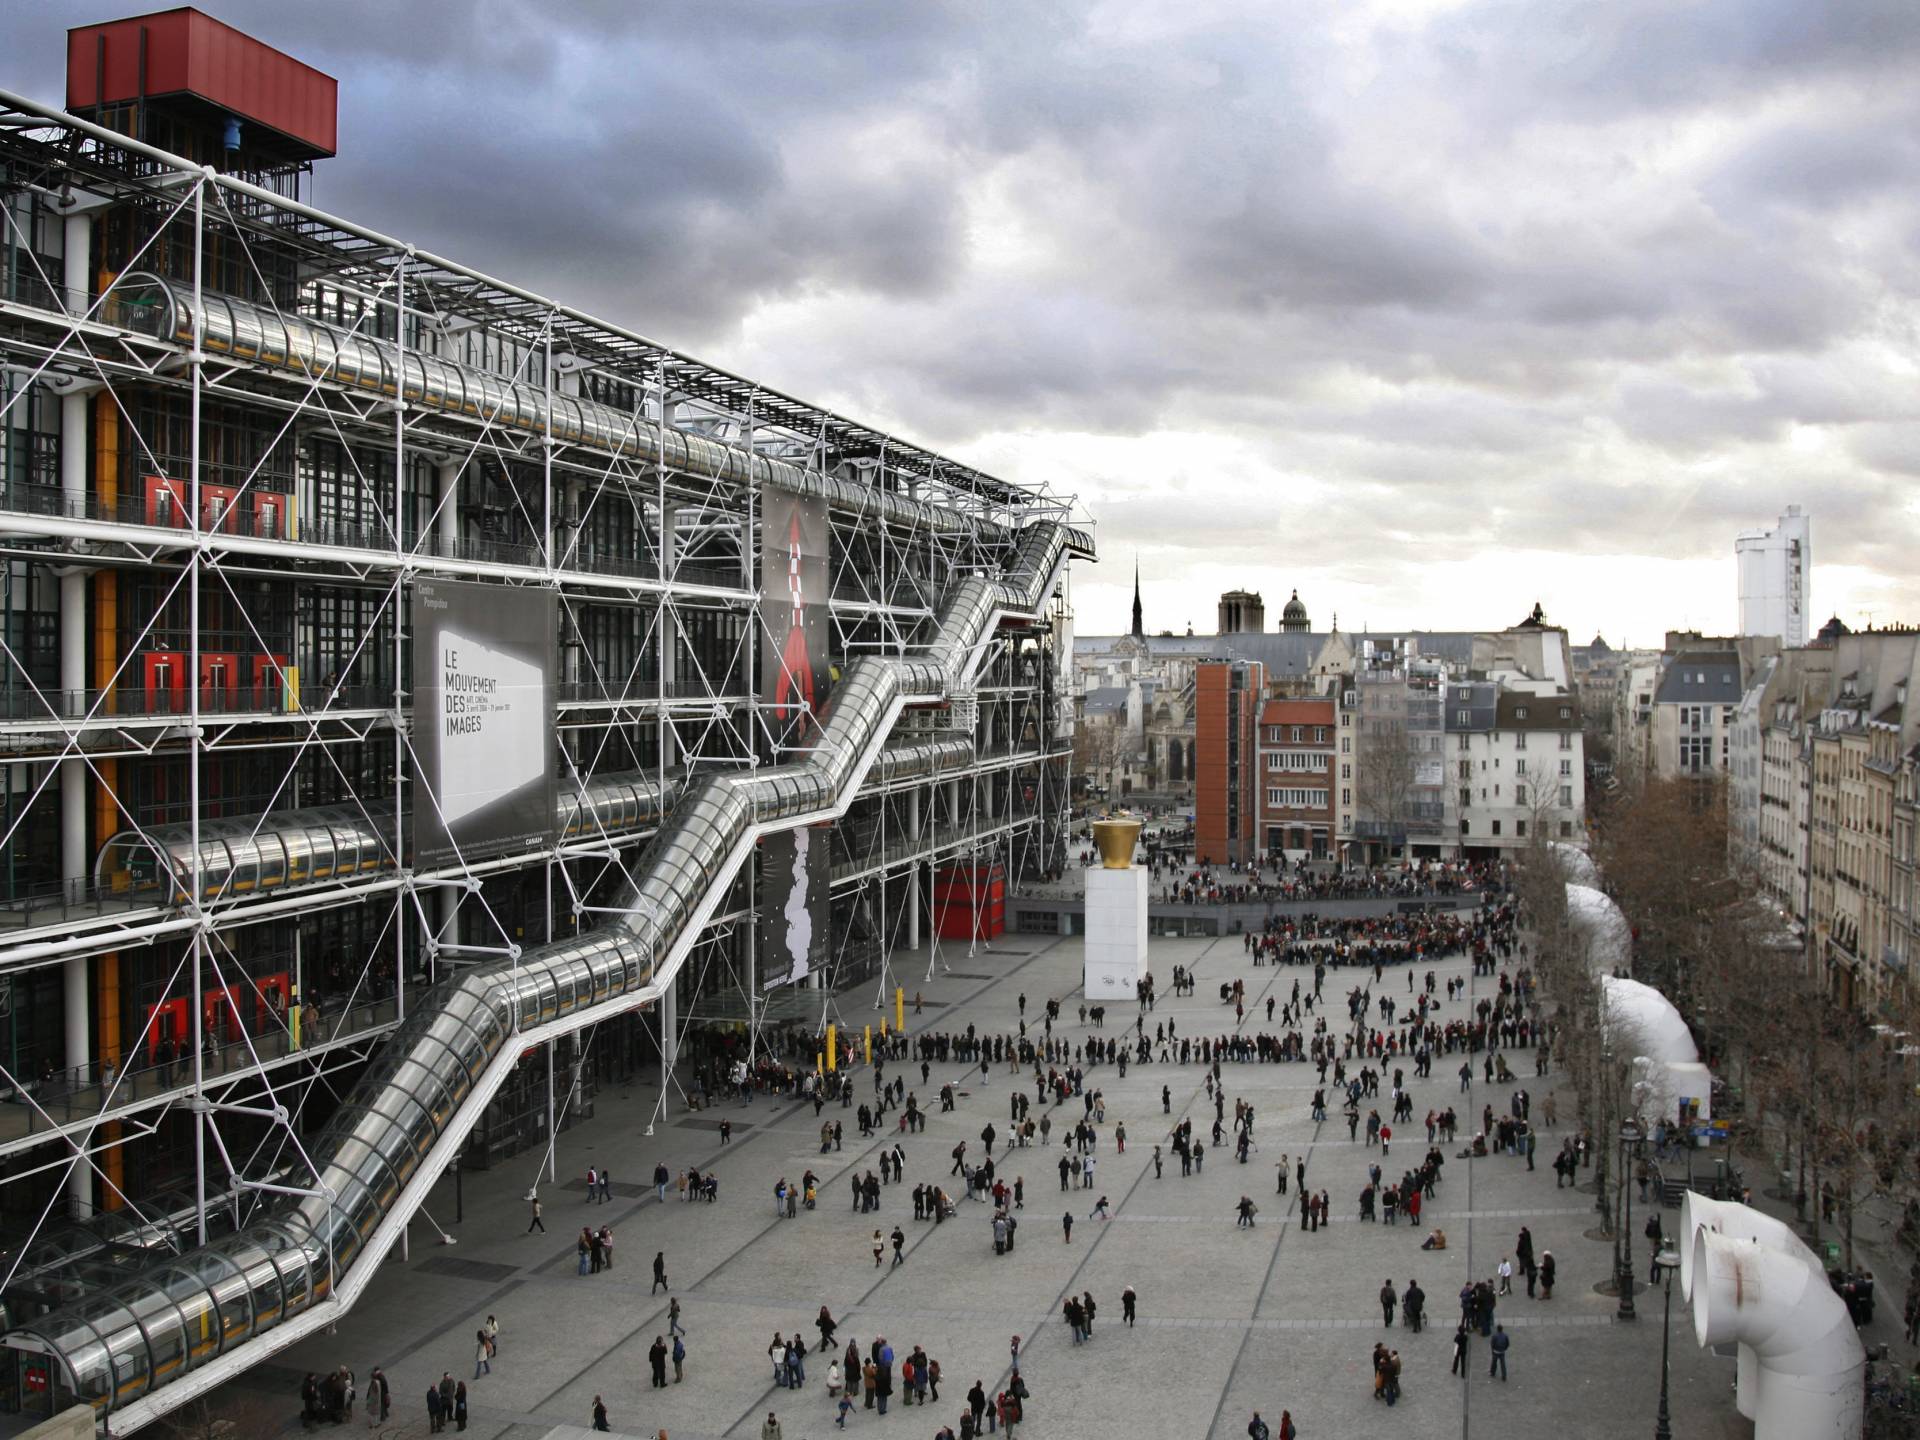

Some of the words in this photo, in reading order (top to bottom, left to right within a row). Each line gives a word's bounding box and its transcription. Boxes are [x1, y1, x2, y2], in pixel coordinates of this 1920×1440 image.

[445, 648, 457, 669] LE
[445, 671, 496, 694] MOUVEMENT
[446, 695, 465, 713] DES
[446, 715, 481, 736] IMAGES
